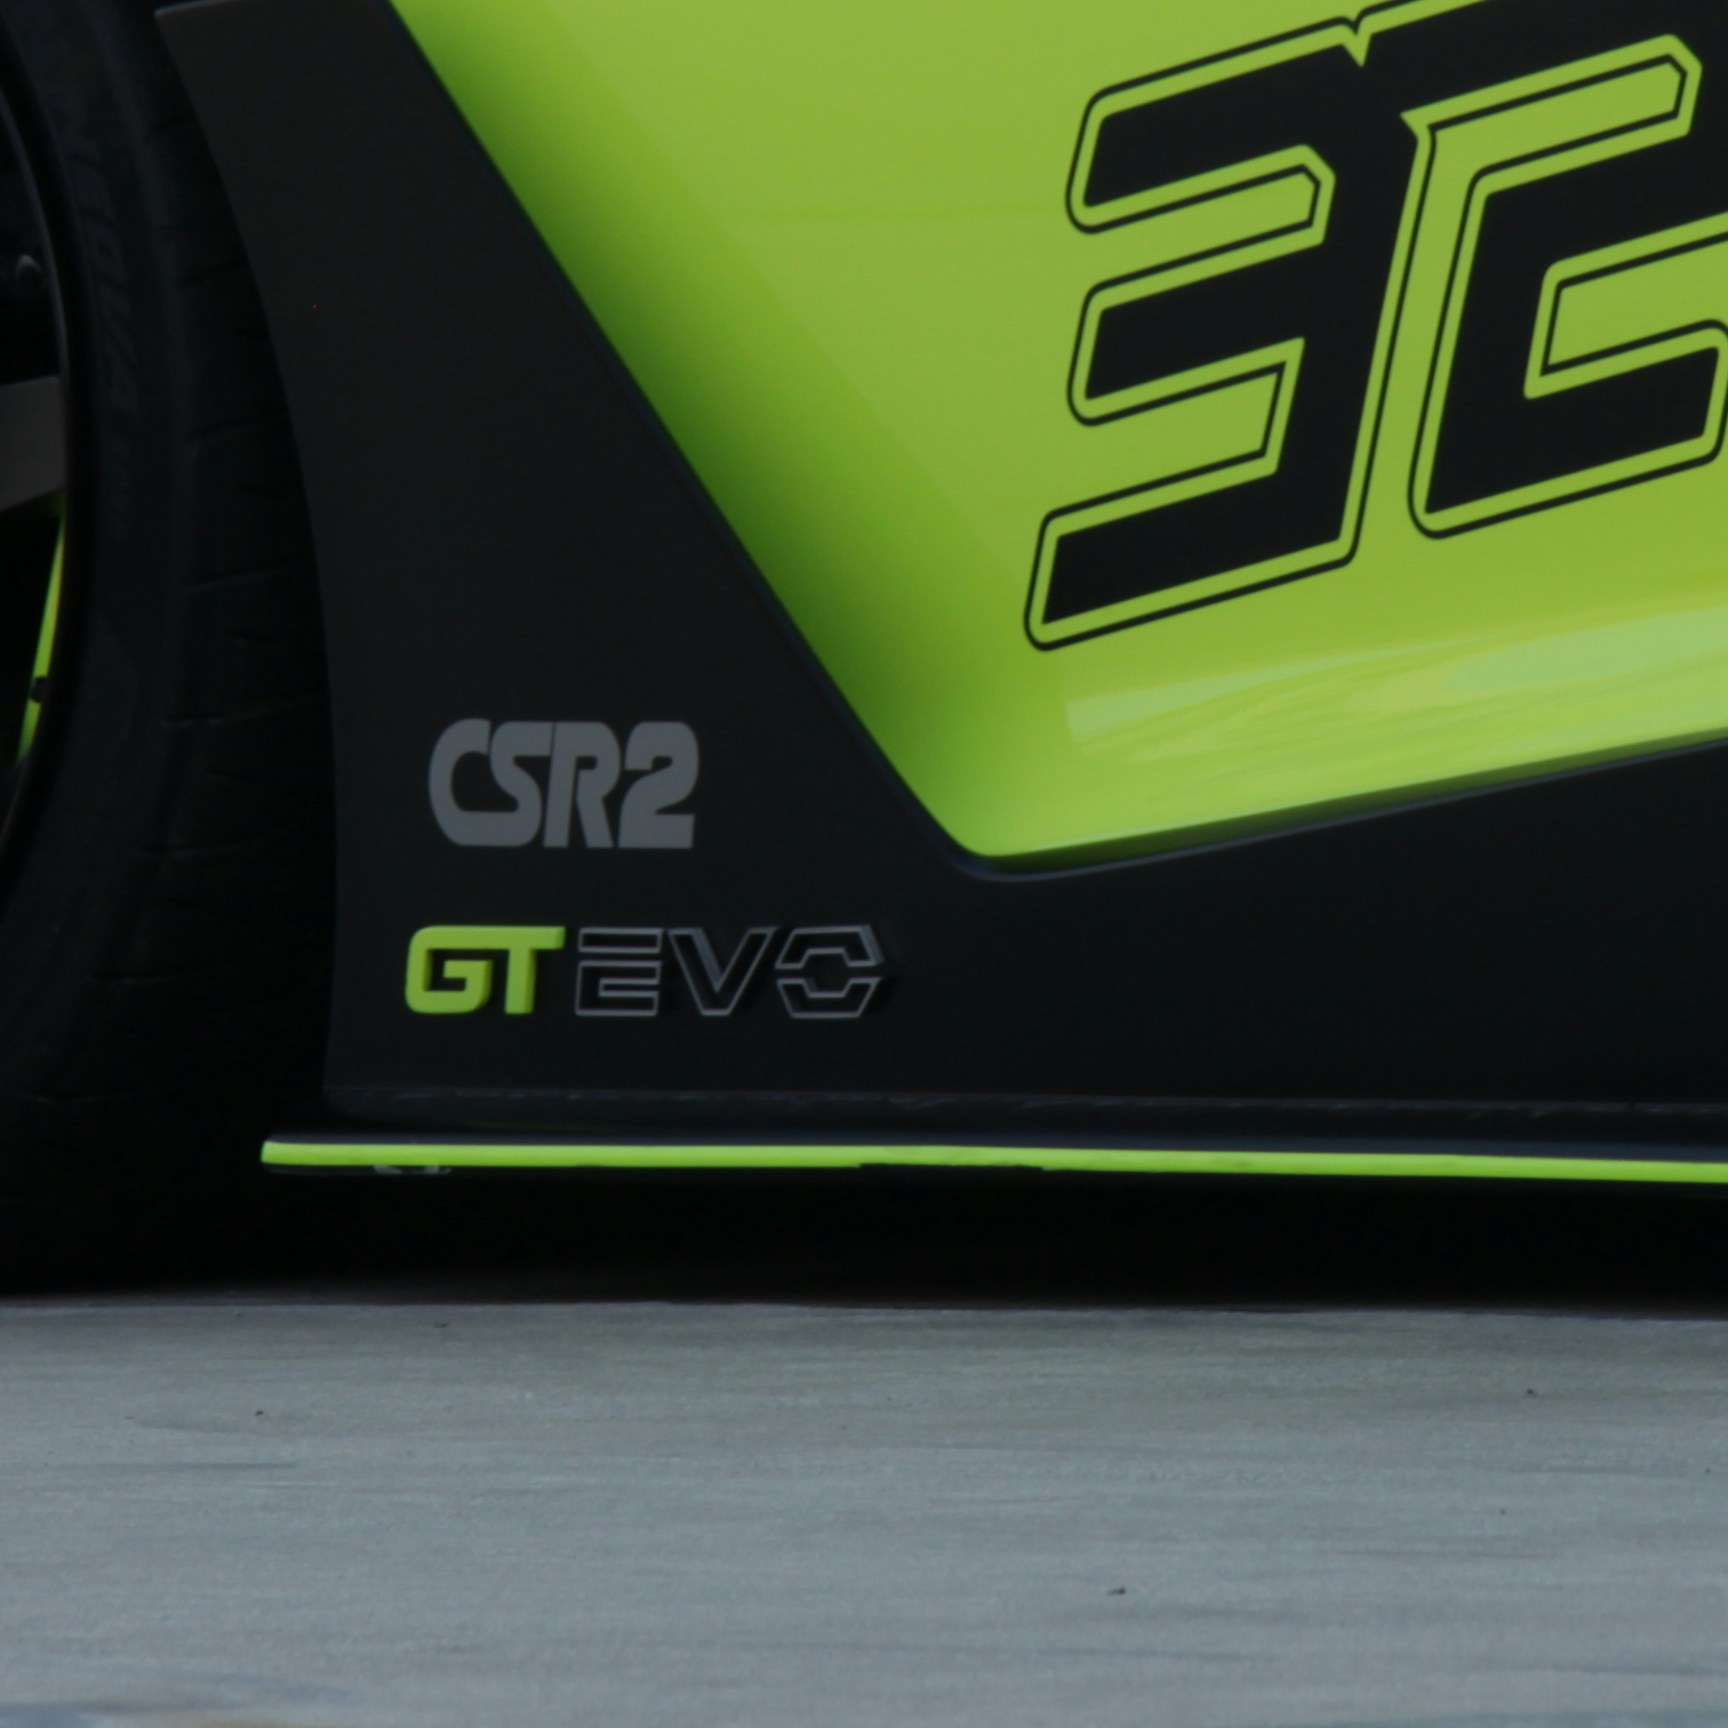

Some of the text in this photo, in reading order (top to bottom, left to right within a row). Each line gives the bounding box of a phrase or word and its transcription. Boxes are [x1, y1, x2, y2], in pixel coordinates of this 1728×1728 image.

[428, 718, 700, 849] CSR2
[404, 924, 883, 1020] GT EVO
